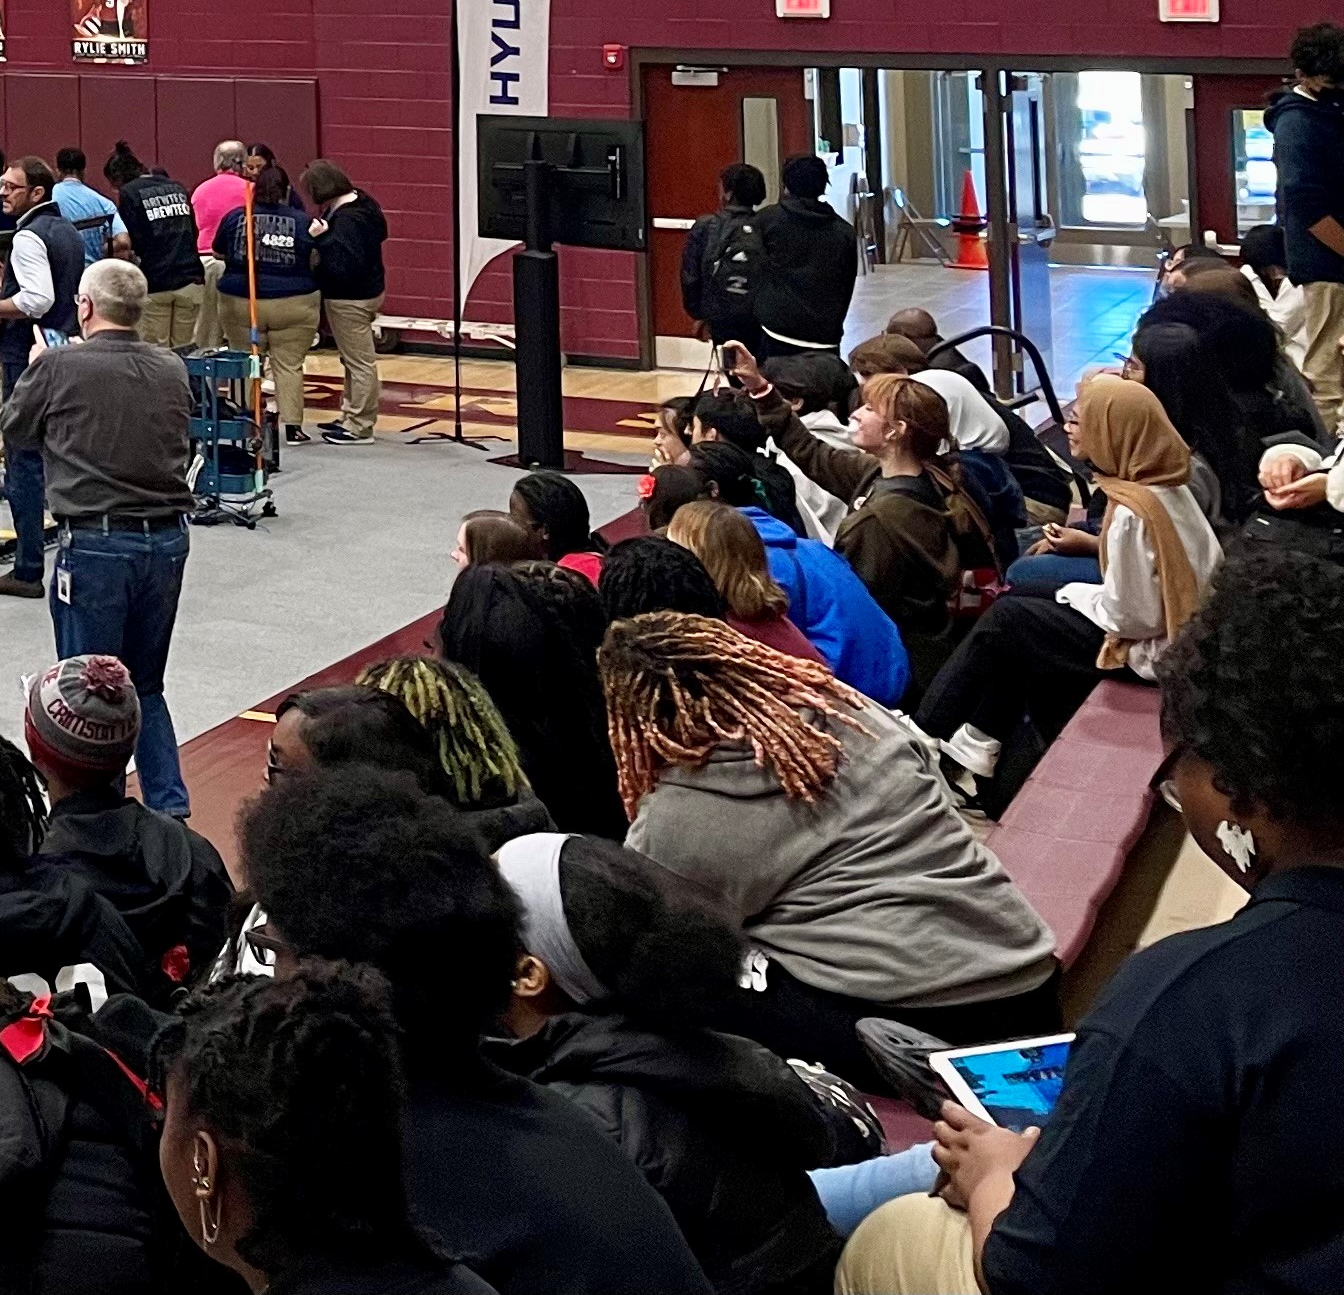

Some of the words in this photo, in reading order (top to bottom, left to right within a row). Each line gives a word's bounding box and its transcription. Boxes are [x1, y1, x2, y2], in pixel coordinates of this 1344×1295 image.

[74, 42, 106, 54] RYLIE
[111, 43, 145, 55] SMITH
[146, 203, 190, 221] BREWTEC
